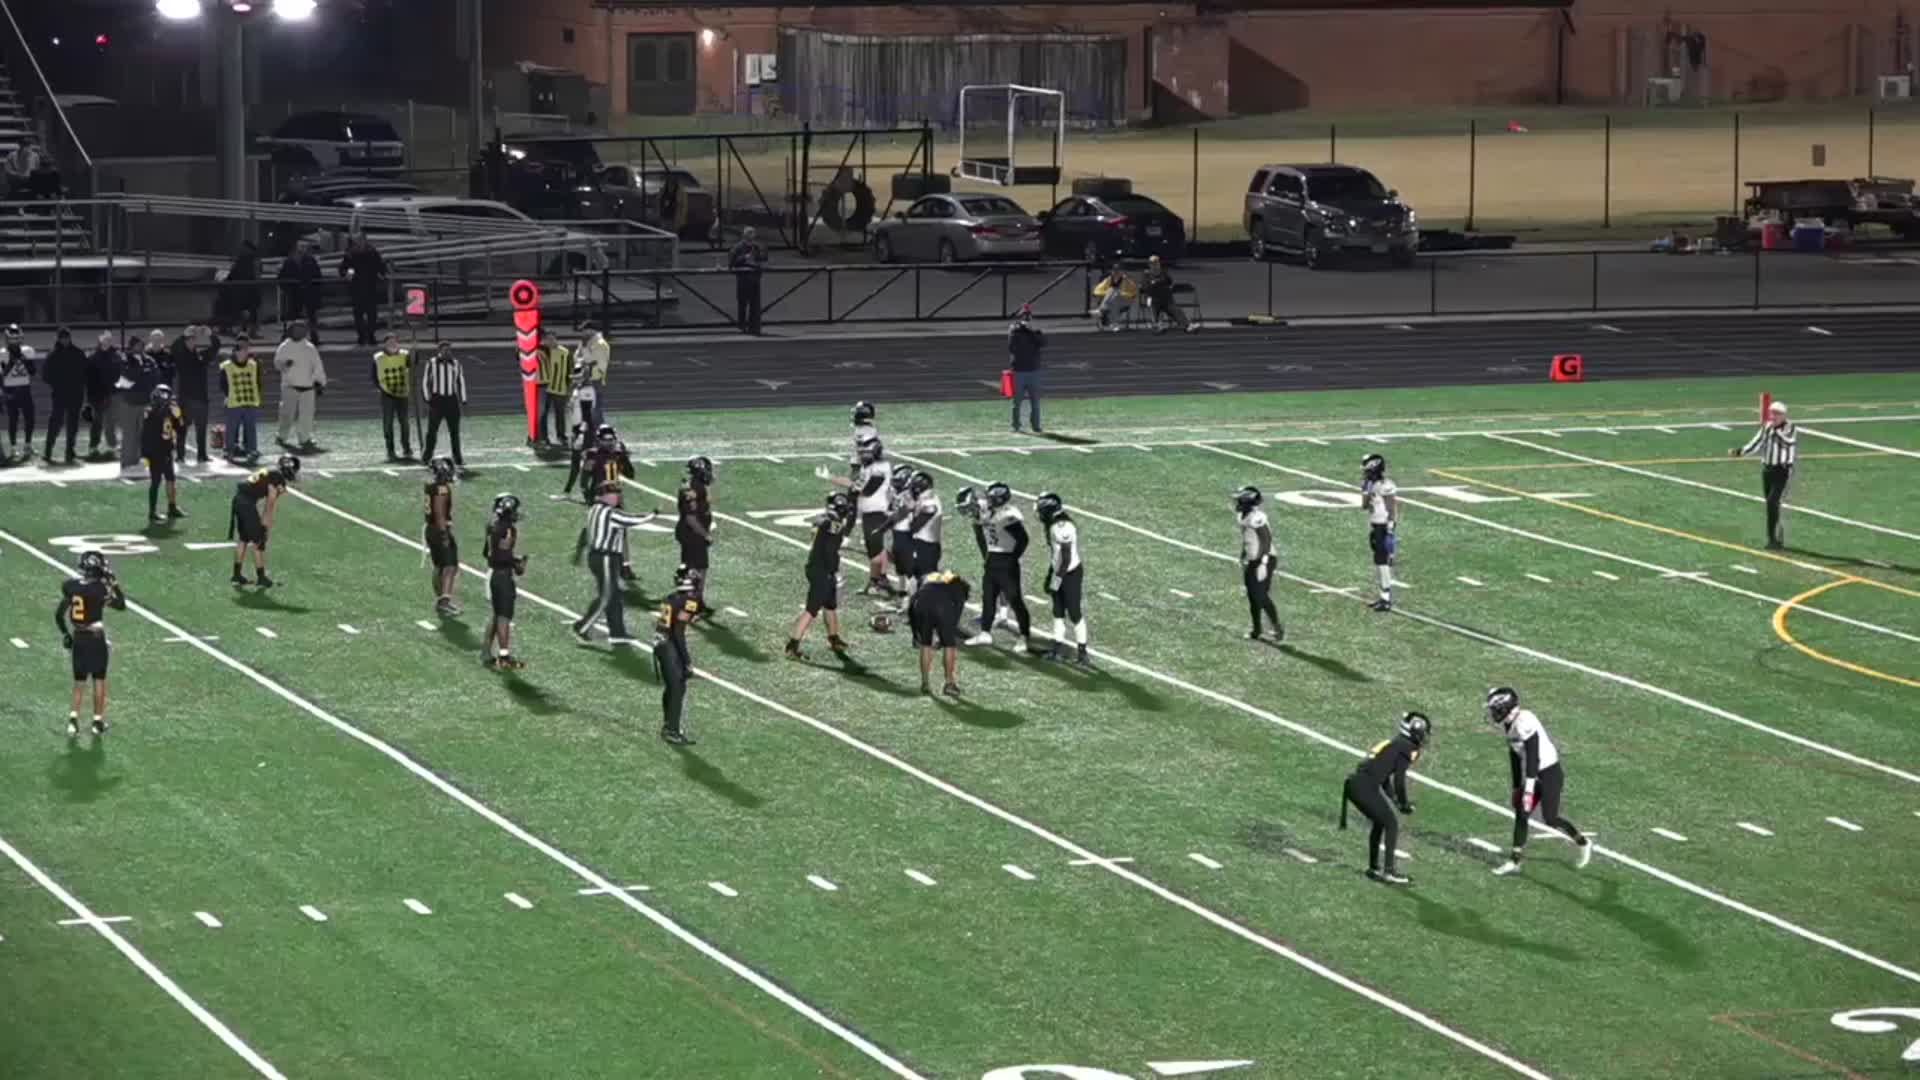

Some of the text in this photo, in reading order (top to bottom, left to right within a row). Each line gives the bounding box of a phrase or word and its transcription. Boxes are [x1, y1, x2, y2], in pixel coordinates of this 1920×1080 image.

[406, 289, 426, 315] 2
[1559, 356, 1577, 376] G
[605, 463, 619, 481] 11
[71, 596, 85, 620] 2
